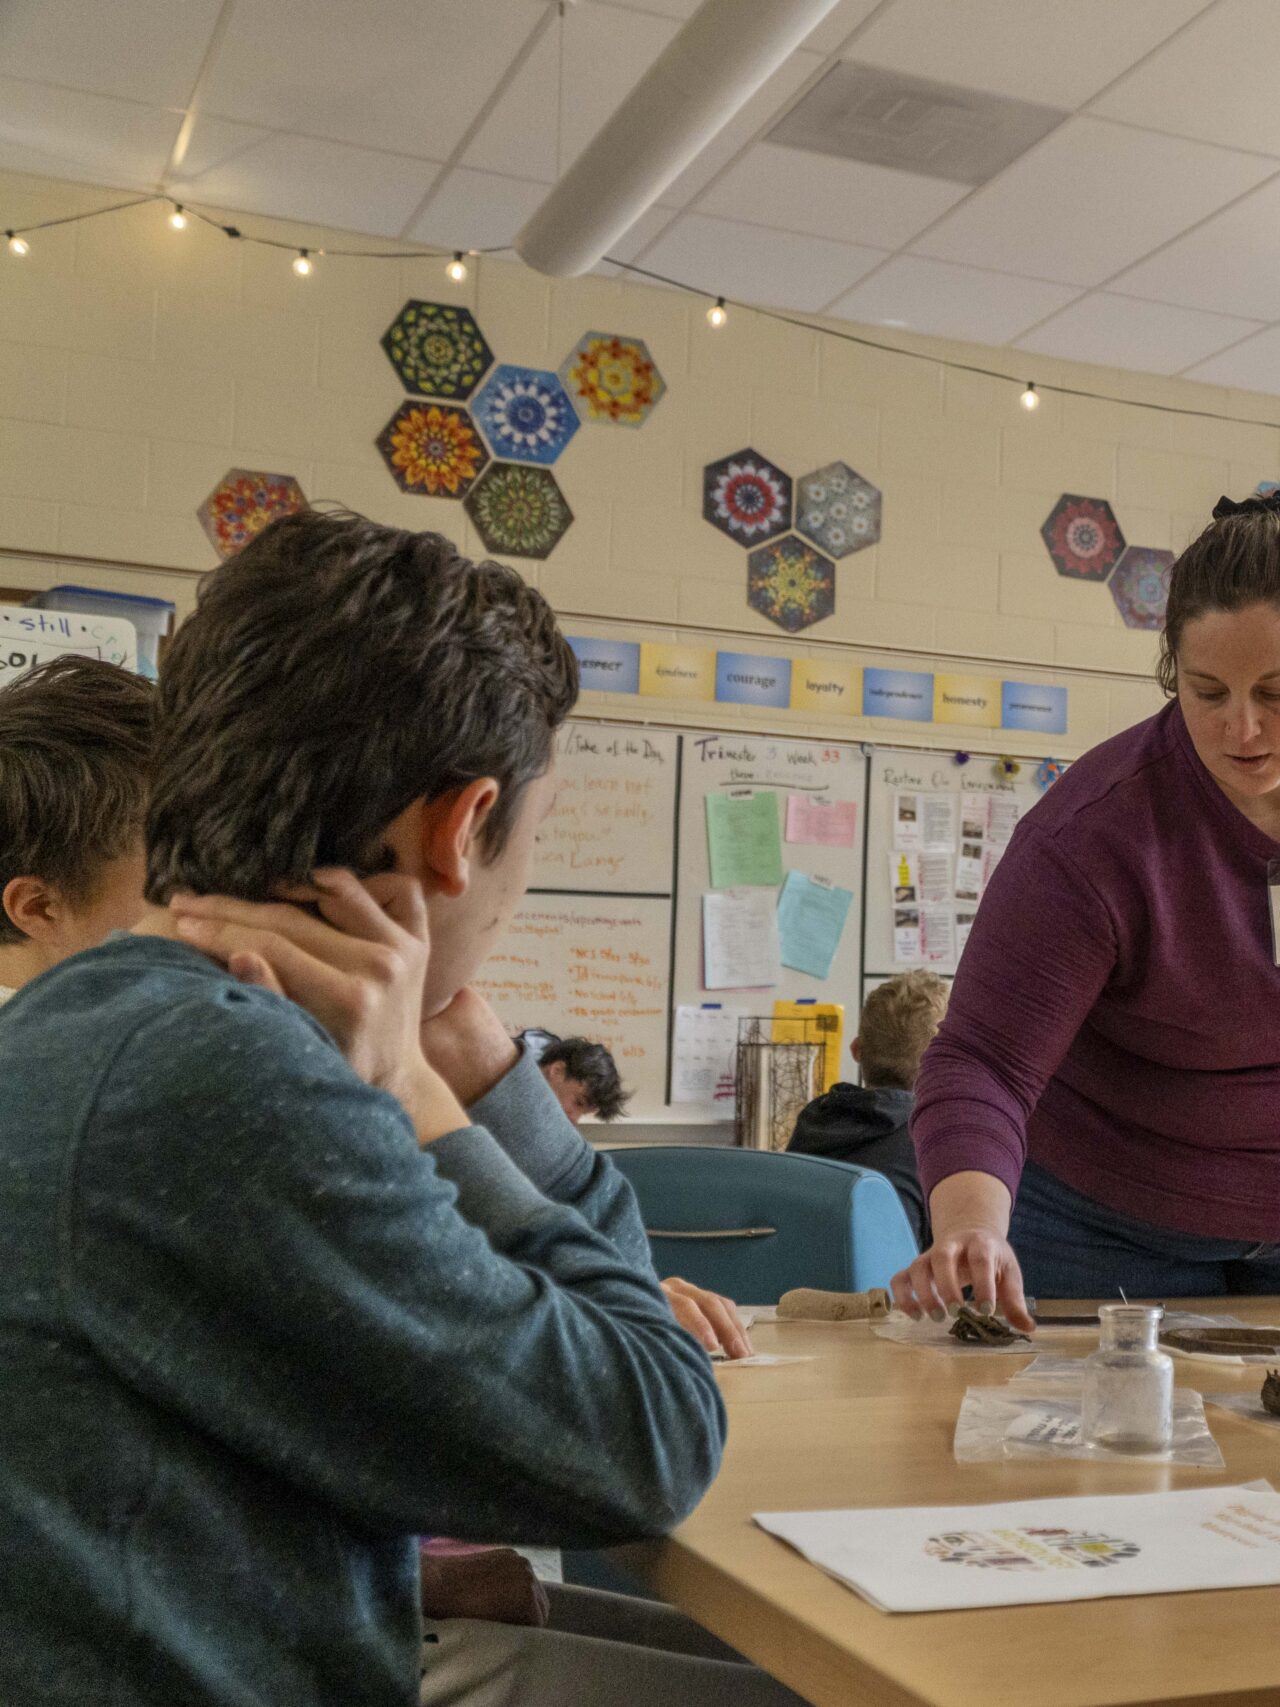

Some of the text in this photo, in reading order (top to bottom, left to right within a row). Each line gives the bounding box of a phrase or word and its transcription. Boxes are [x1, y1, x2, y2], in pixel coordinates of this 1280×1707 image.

[19, 614, 71, 638] still
[727, 673, 776, 689] courage
[806, 679, 844, 696] loyalty
[942, 692, 987, 710] honesty
[694, 736, 757, 762] Trimester
[787, 750, 817, 766] Week
